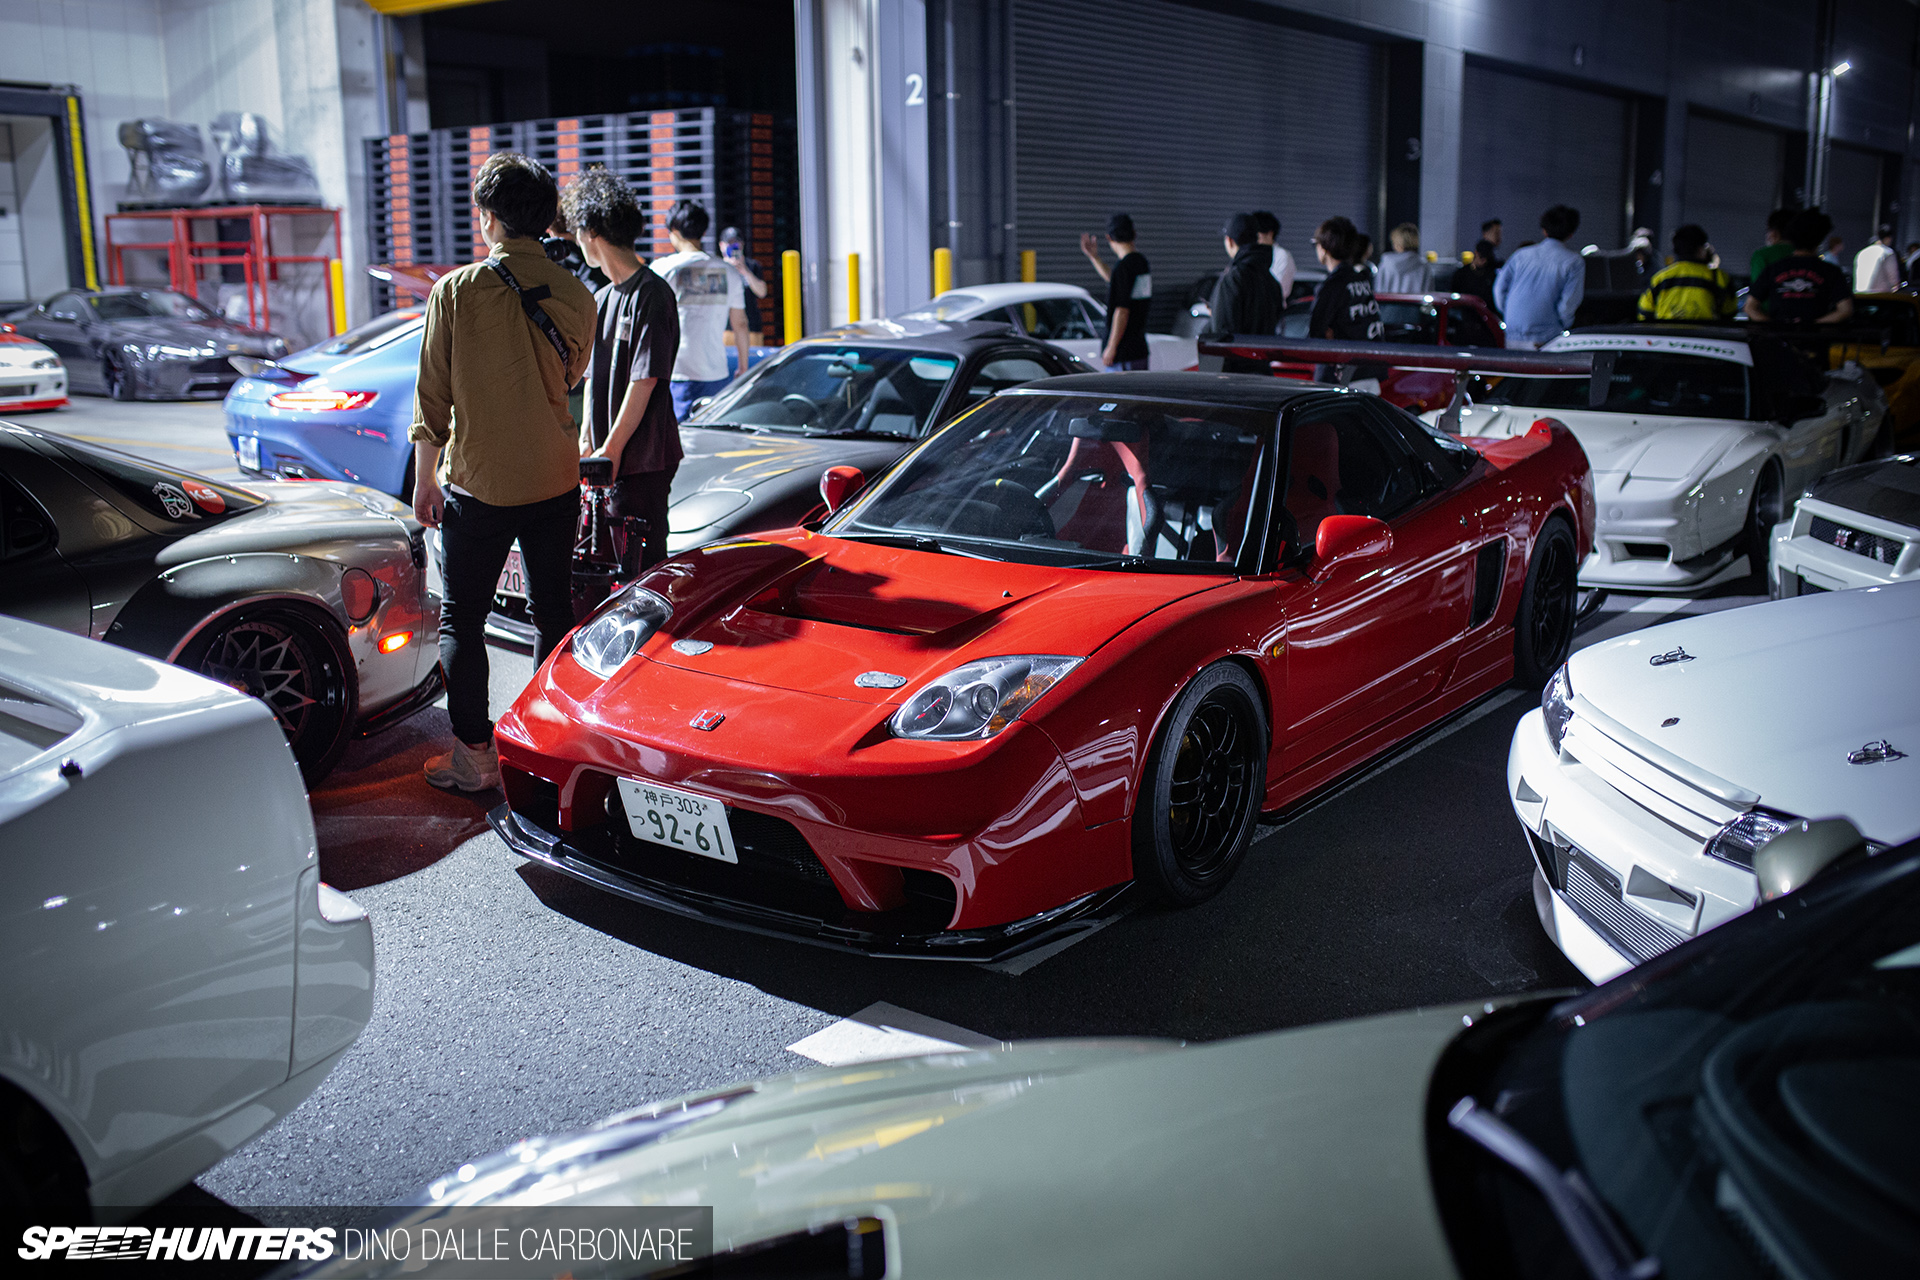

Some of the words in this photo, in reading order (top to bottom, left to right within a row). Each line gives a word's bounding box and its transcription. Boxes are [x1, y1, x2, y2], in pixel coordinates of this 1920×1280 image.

[905, 73, 925, 107] 2
[1405, 136, 1421, 161] 3
[632, 815, 645, 826] つ
[647, 809, 726, 857] 92-61
